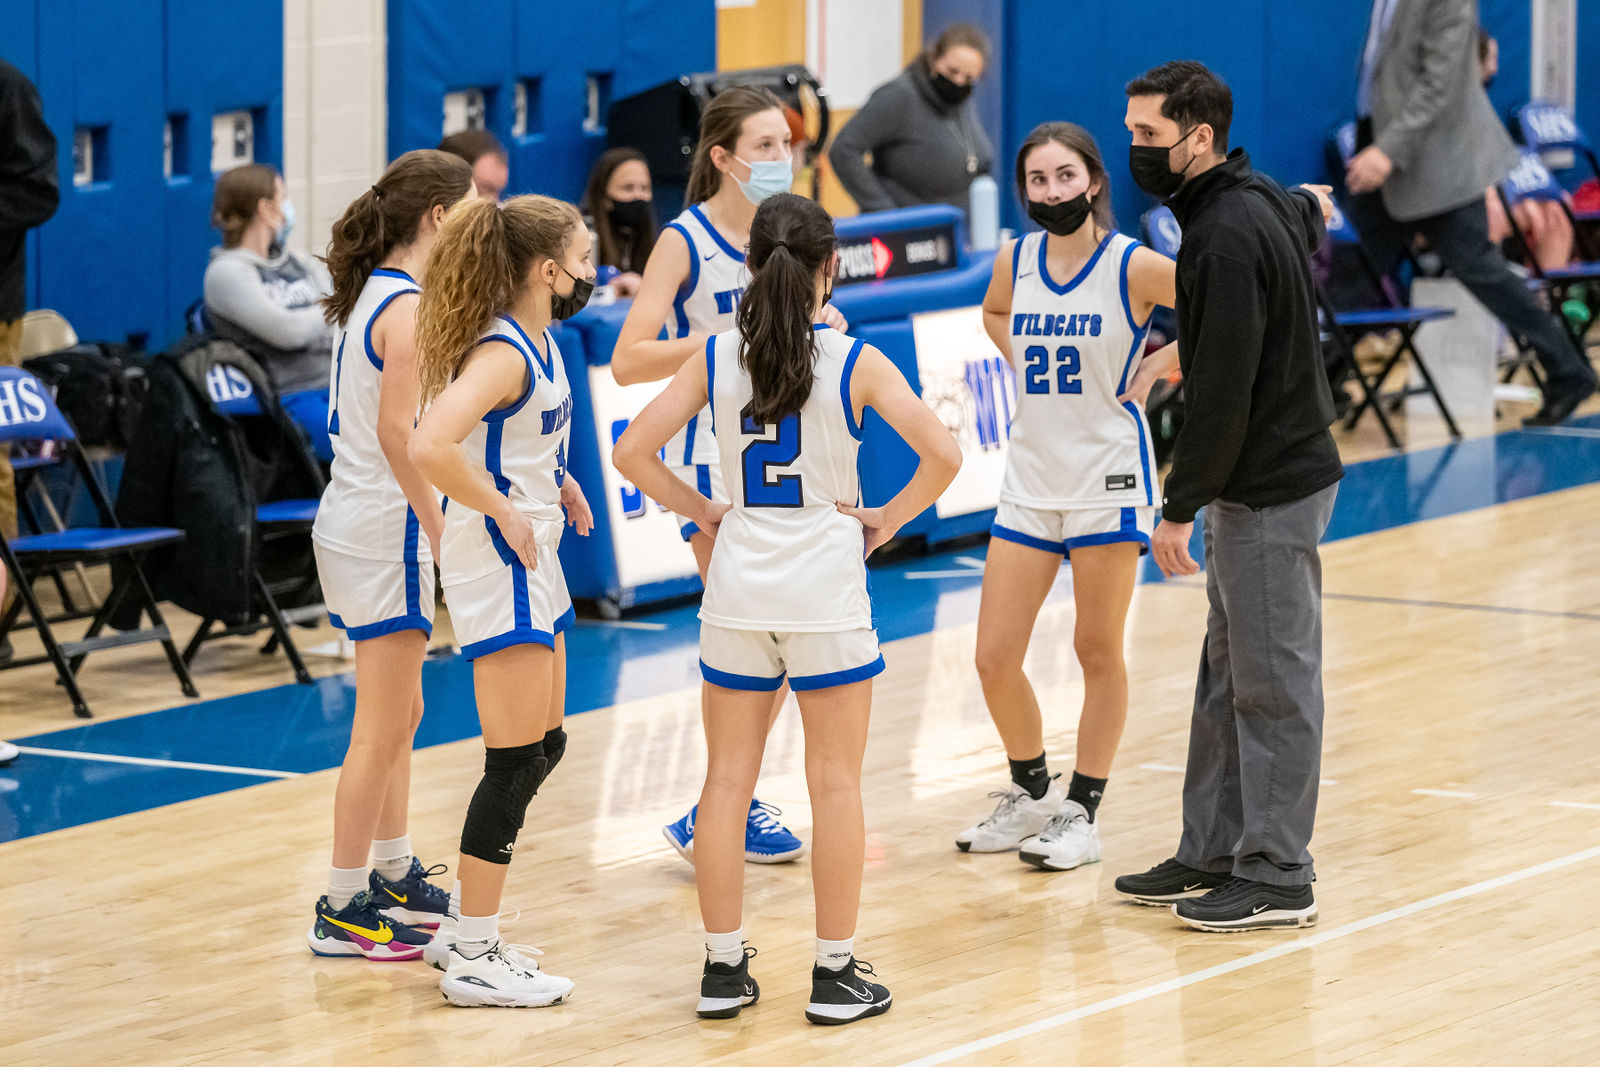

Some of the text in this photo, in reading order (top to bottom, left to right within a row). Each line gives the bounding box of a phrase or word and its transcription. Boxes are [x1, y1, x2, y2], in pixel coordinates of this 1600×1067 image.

[1013, 313, 1102, 336] WILDCATS
[1025, 344, 1083, 395] 22
[740, 399, 804, 508] 2
